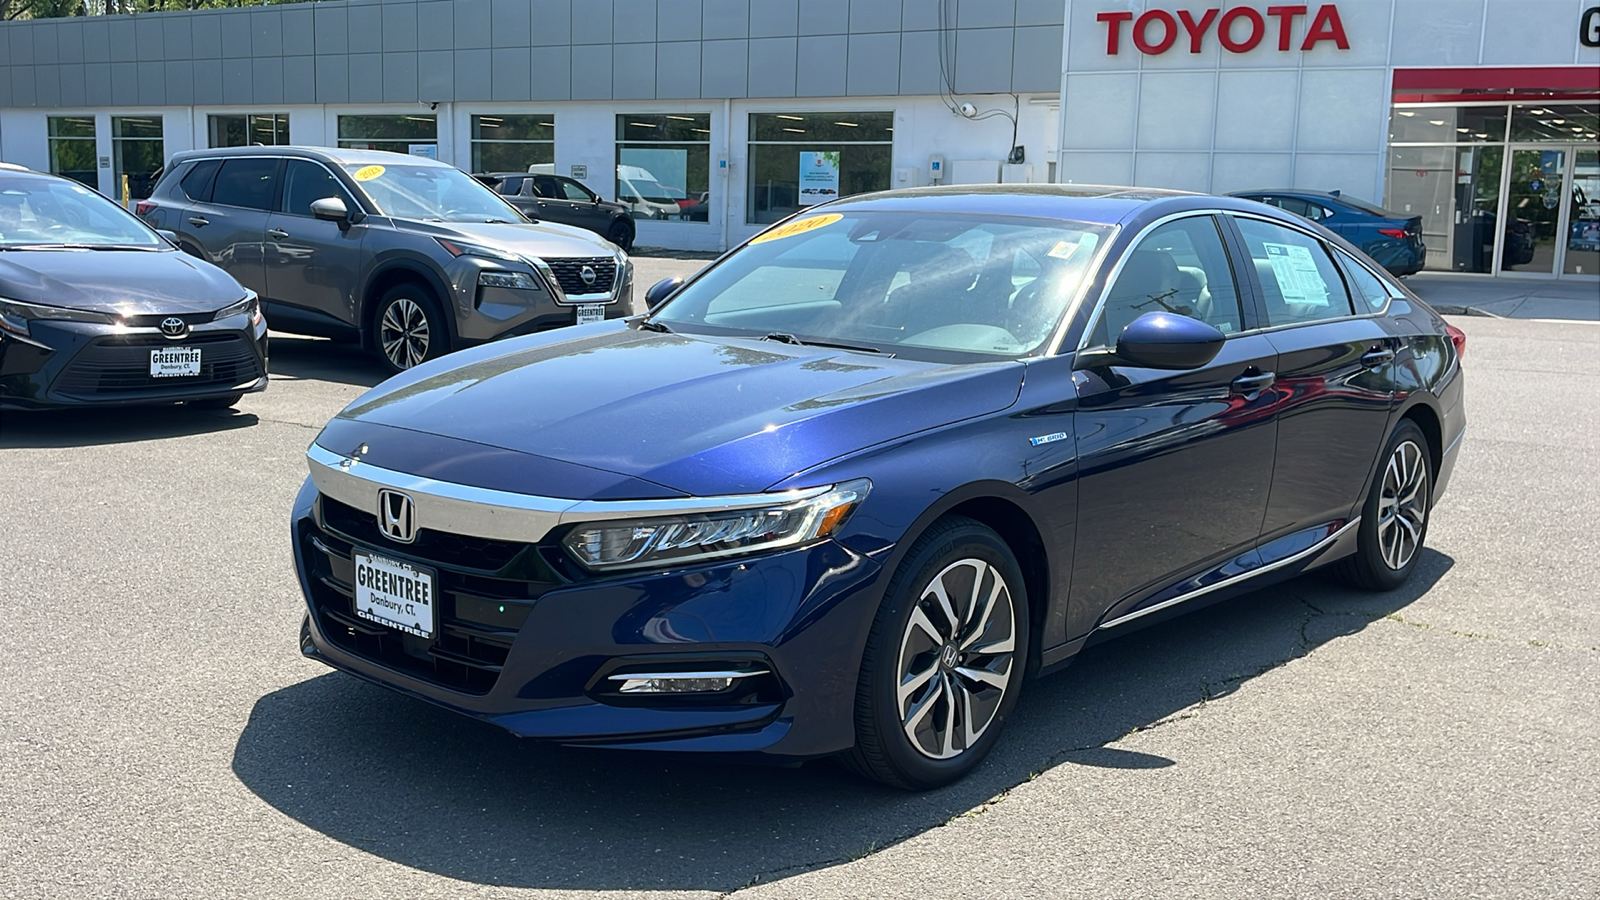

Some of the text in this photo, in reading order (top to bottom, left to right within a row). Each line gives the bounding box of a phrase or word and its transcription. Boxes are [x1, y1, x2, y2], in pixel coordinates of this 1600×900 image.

[1097, 4, 1350, 55] TOYOTA
[152, 352, 199, 364] GREENTREE
[357, 564, 429, 606] GREENTREE
[370, 592, 416, 616] Danbury, CT.
[357, 610, 430, 639] GREENTREE
